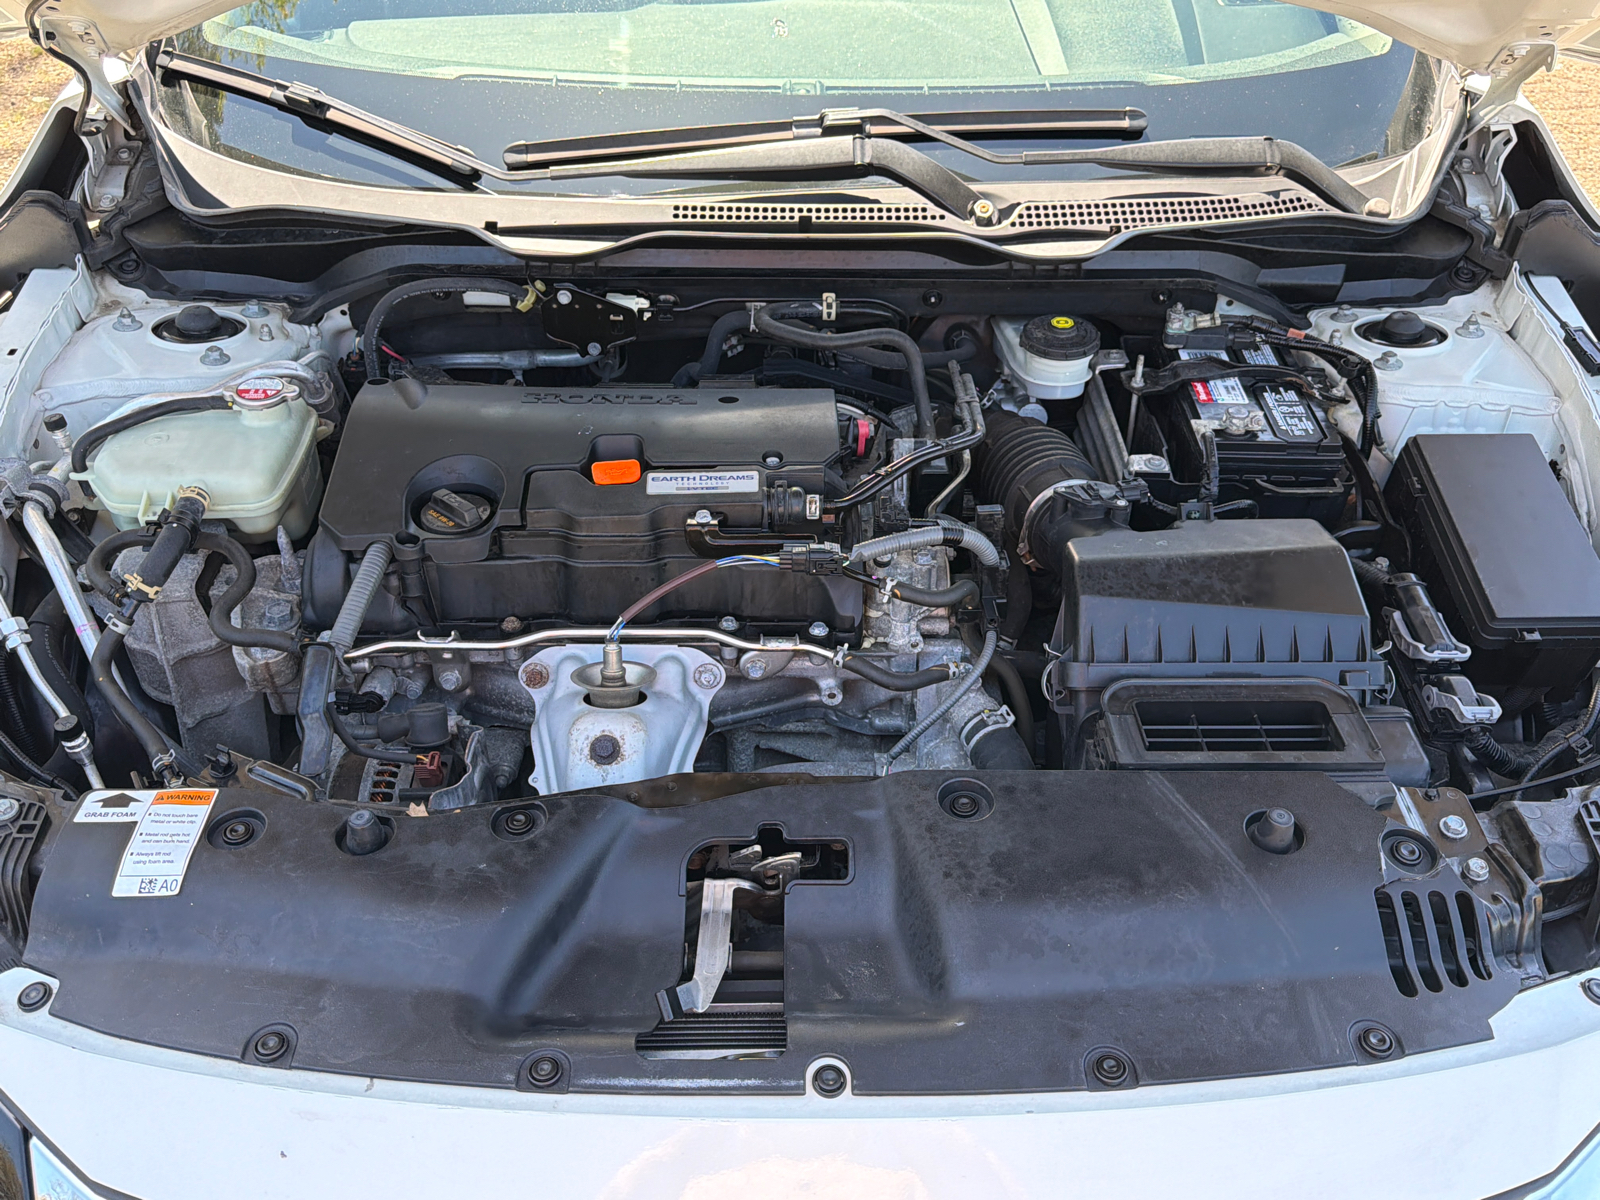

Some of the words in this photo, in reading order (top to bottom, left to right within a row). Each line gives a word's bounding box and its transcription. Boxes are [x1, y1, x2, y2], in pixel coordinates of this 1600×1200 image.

[520, 392, 698, 405] HONDA
[699, 474, 755, 482] DREAMS
[158, 878, 179, 893] A0
